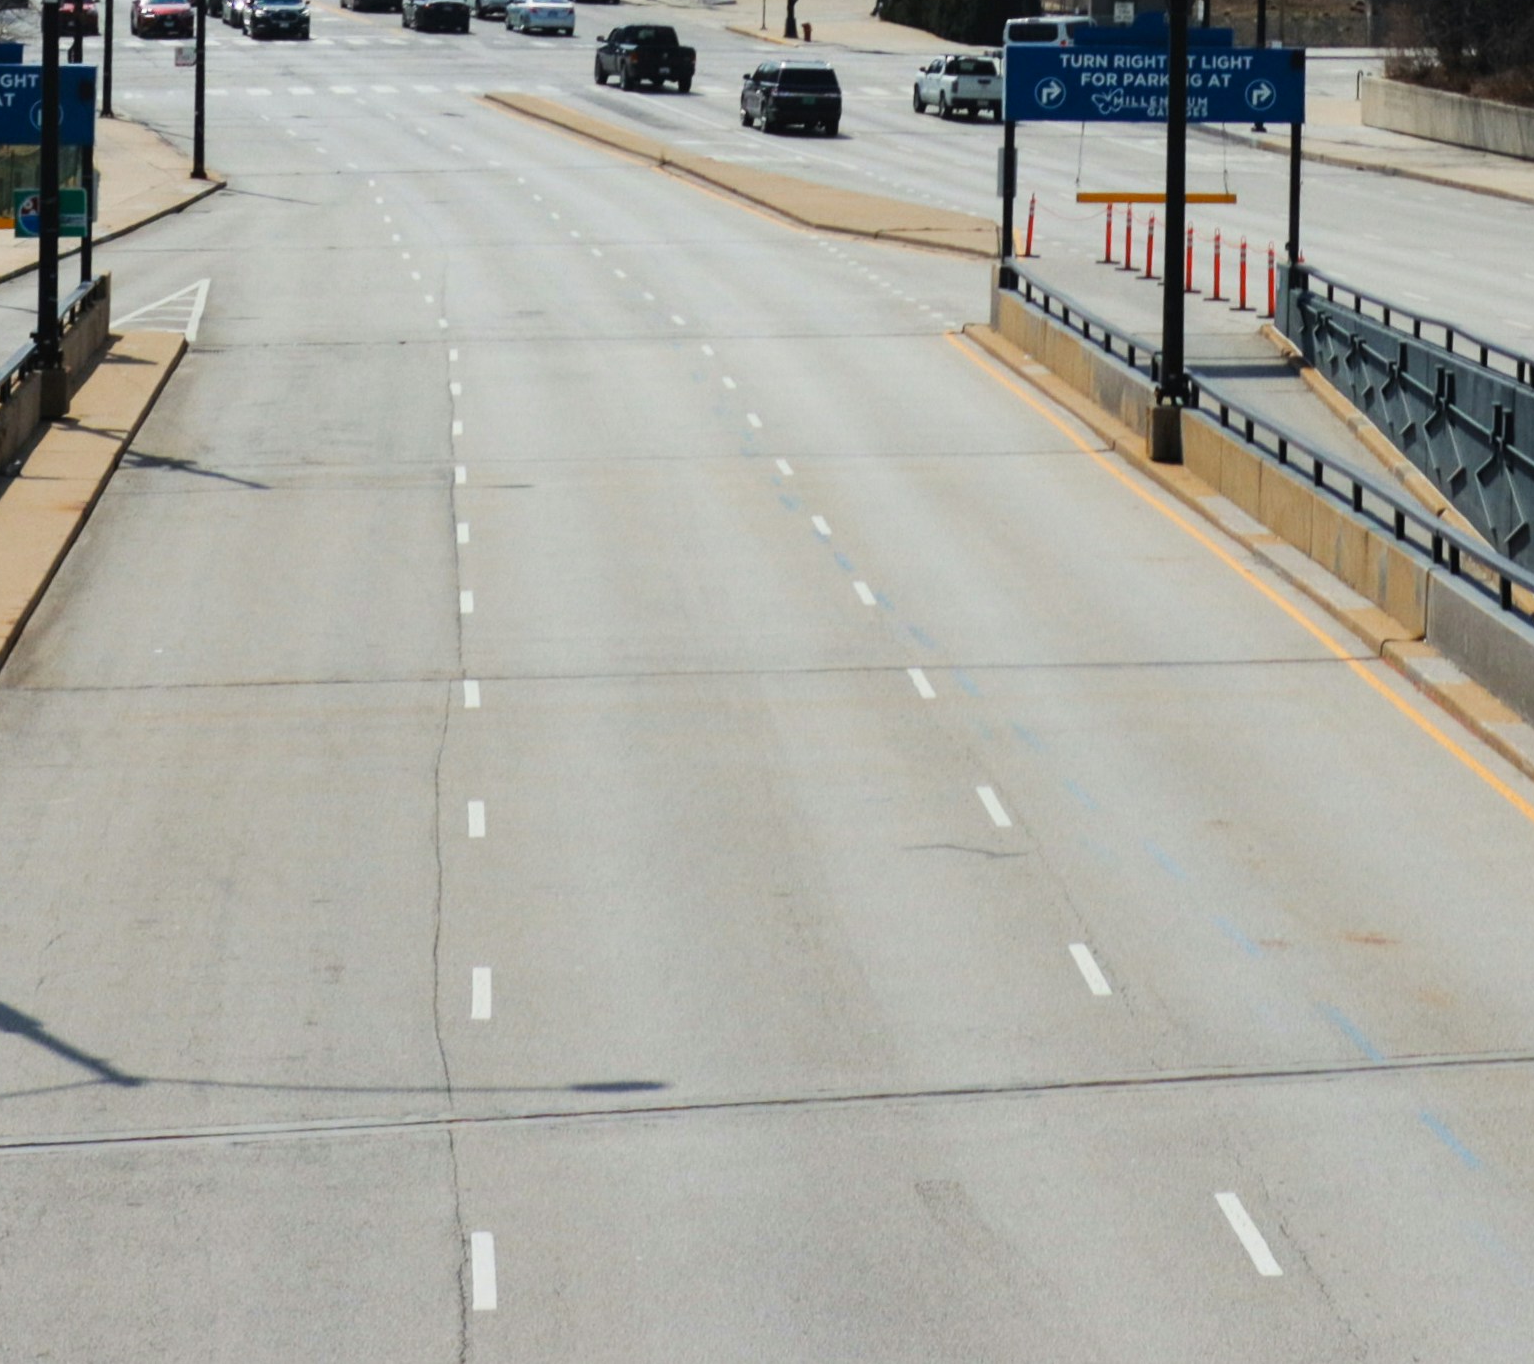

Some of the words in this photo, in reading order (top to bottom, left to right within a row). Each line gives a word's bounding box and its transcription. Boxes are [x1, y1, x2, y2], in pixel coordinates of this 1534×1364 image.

[1060, 54, 1108, 68] TURN
[1114, 54, 1167, 69] RIGHT
[1202, 56, 1253, 70] LIGHT
[1081, 73, 1117, 86] FOR
[1123, 73, 1202, 87] PARKG
[1208, 74, 1232, 87] AT
[1114, 96, 1208, 107] MILLENUM
